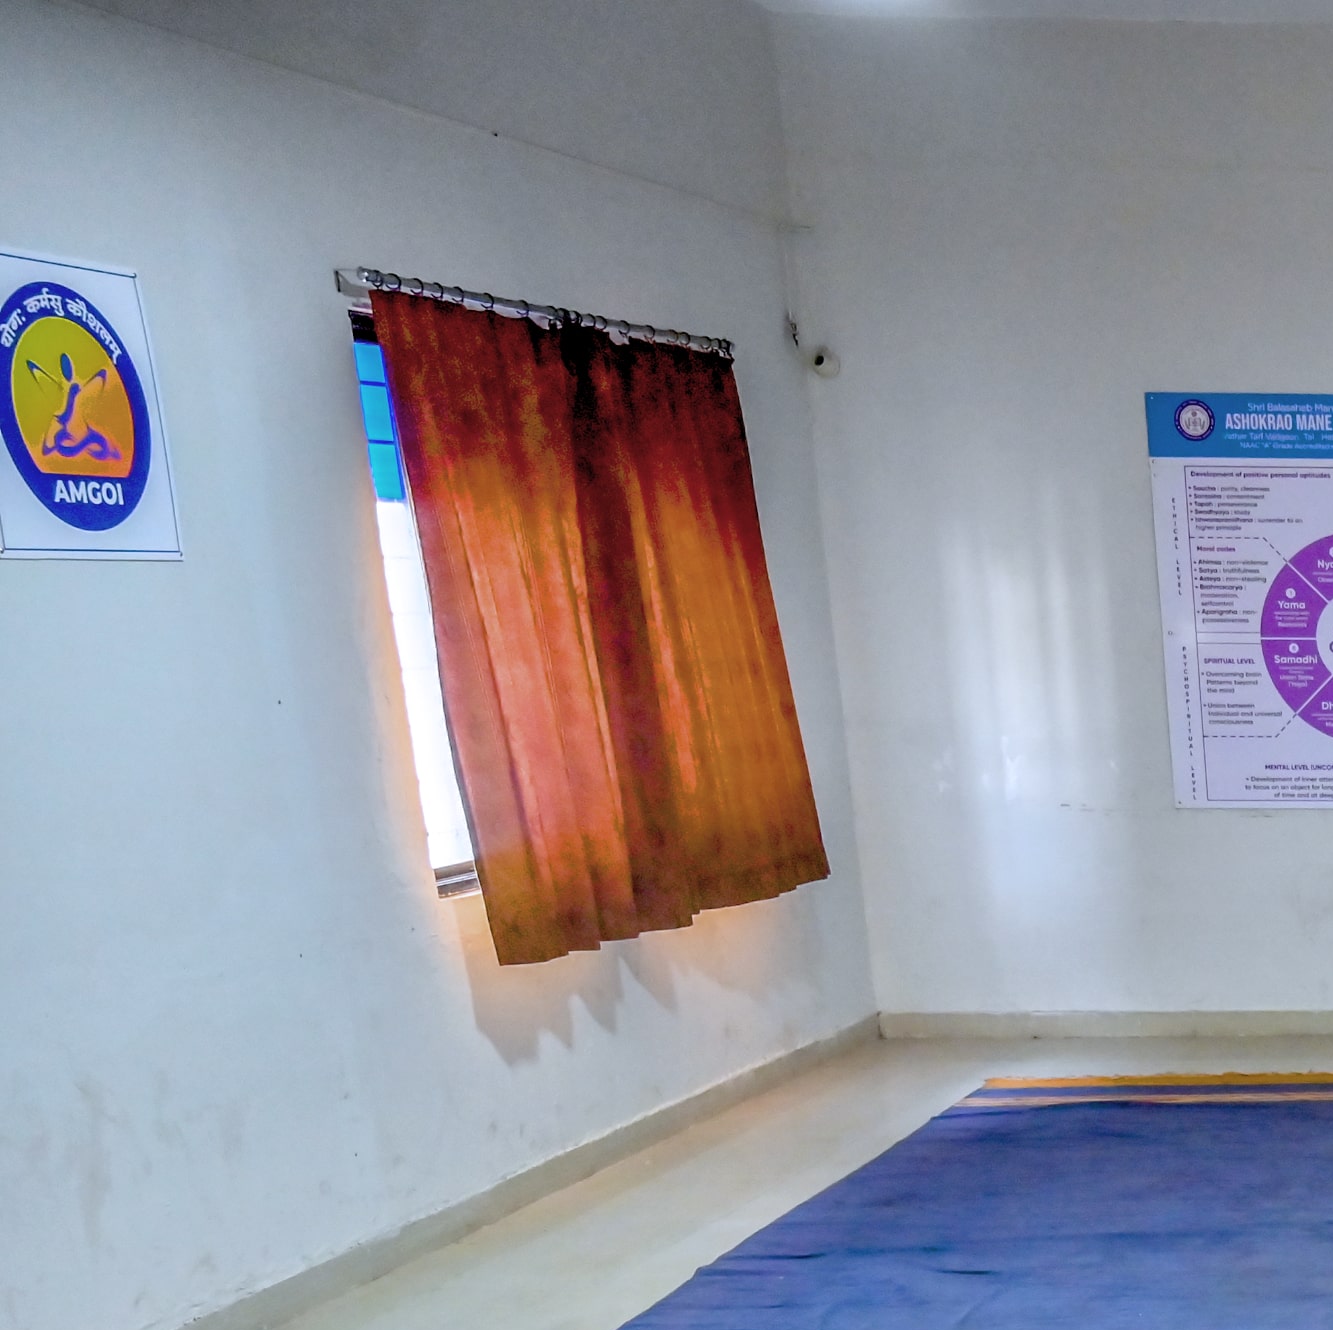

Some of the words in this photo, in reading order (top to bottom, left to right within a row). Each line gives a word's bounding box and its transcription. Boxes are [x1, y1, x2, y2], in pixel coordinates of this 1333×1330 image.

[23, 287, 65, 317] कर्मसु
[1225, 413, 1293, 430] ASHOKRAO
[1296, 414, 1332, 431] MANE
[54, 480, 125, 506] AMGOI
[1277, 600, 1306, 609] Yama
[1274, 654, 1318, 665] Samadhi
